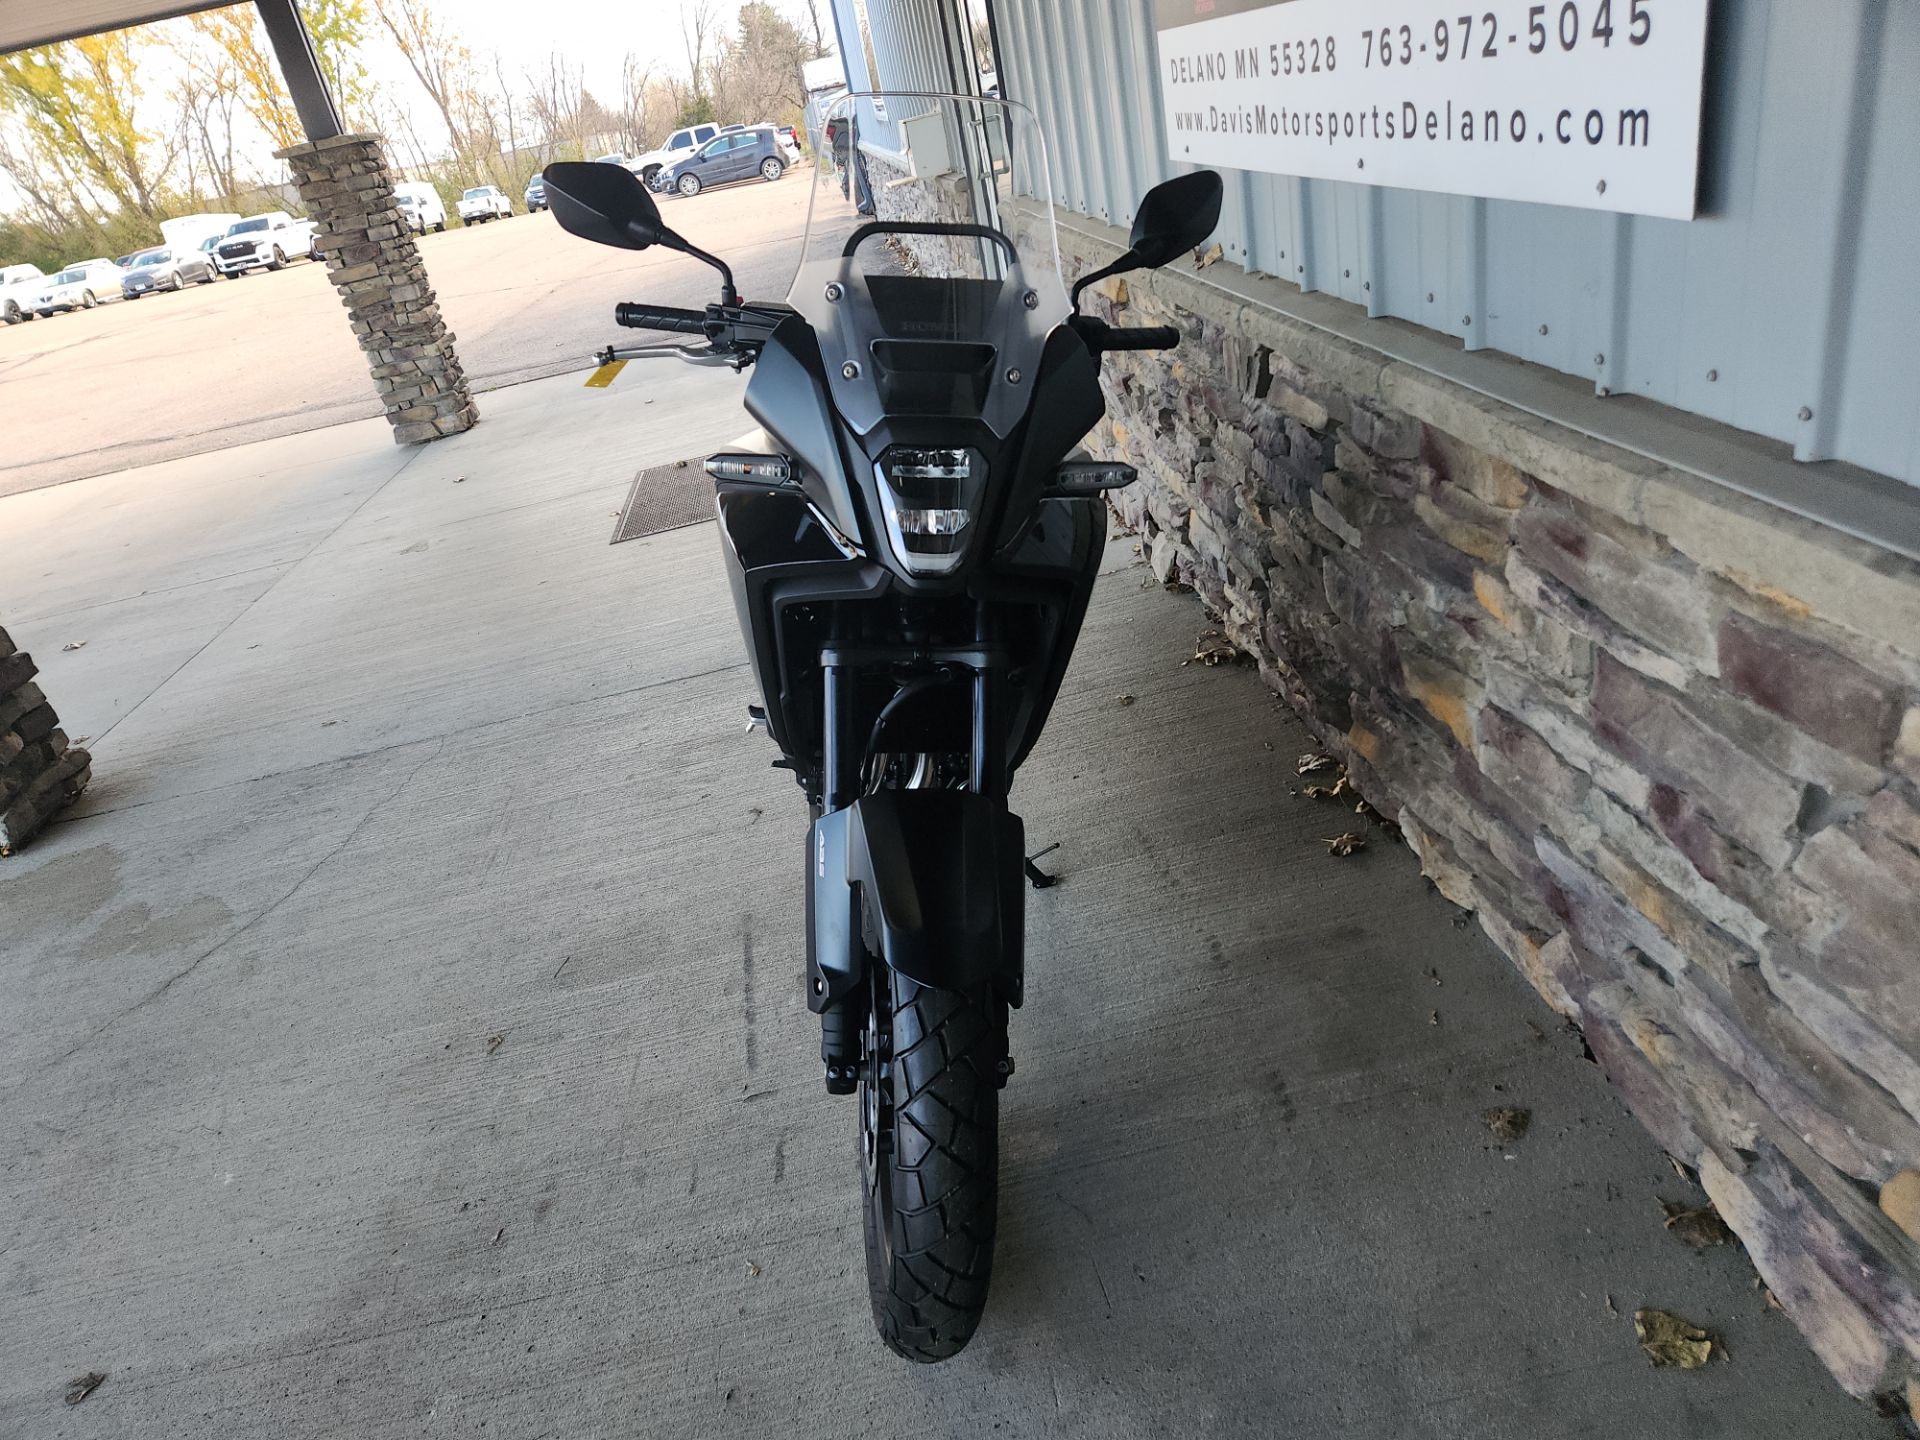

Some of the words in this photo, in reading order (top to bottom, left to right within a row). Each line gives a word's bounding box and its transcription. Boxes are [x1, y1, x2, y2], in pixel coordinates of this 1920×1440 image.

[1170, 52, 1226, 84] DELANO
[1235, 47, 1259, 79] MN
[1270, 36, 1336, 77] 55328
[1361, 0, 1651, 69] 763-972-5045
[1175, 101, 1649, 147] www.DavisMotorsportsDelano.com
